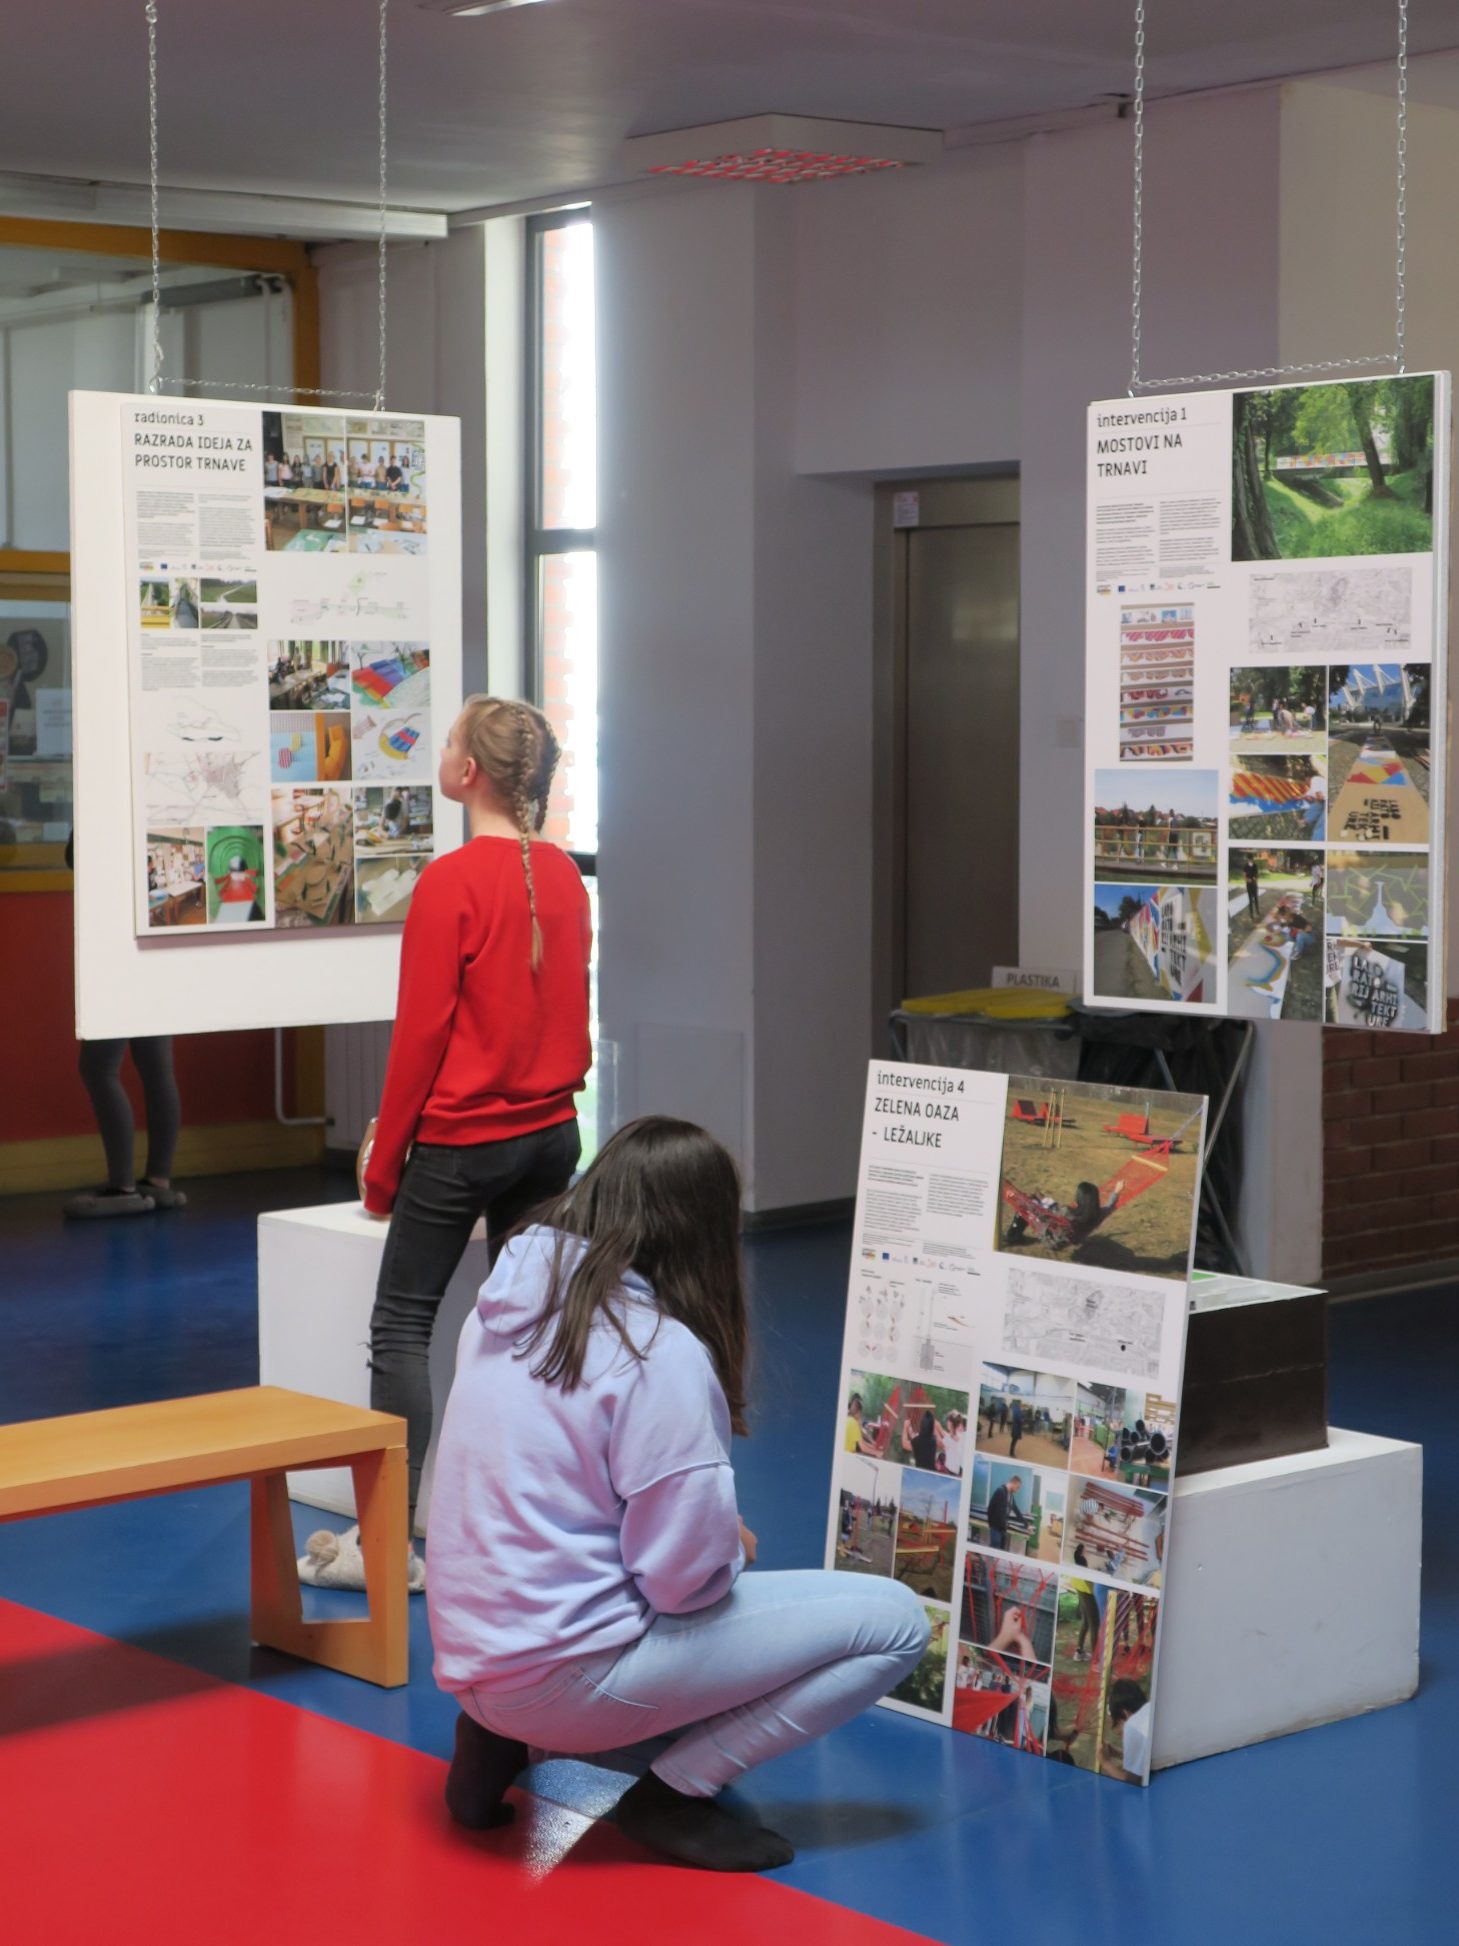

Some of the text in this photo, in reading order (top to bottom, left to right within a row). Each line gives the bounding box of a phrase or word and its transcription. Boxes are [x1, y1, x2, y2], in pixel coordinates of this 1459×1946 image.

[134, 411, 204, 426] radionica 3
[1096, 407, 1187, 428] intervencija 1
[134, 433, 253, 451] RAZRADA IDEJA ZA
[1096, 433, 1183, 454] MOSTOVI NA
[135, 454, 246, 472] PROSTOR TRNAVE
[1097, 460, 1148, 477] TRNAVI
[1007, 973, 1060, 988] PLASTIKA
[877, 1071, 965, 1095] intervencija 4
[874, 1097, 960, 1122] ZELENA OAZA
[883, 1125, 943, 1149] LEŽALJKE
